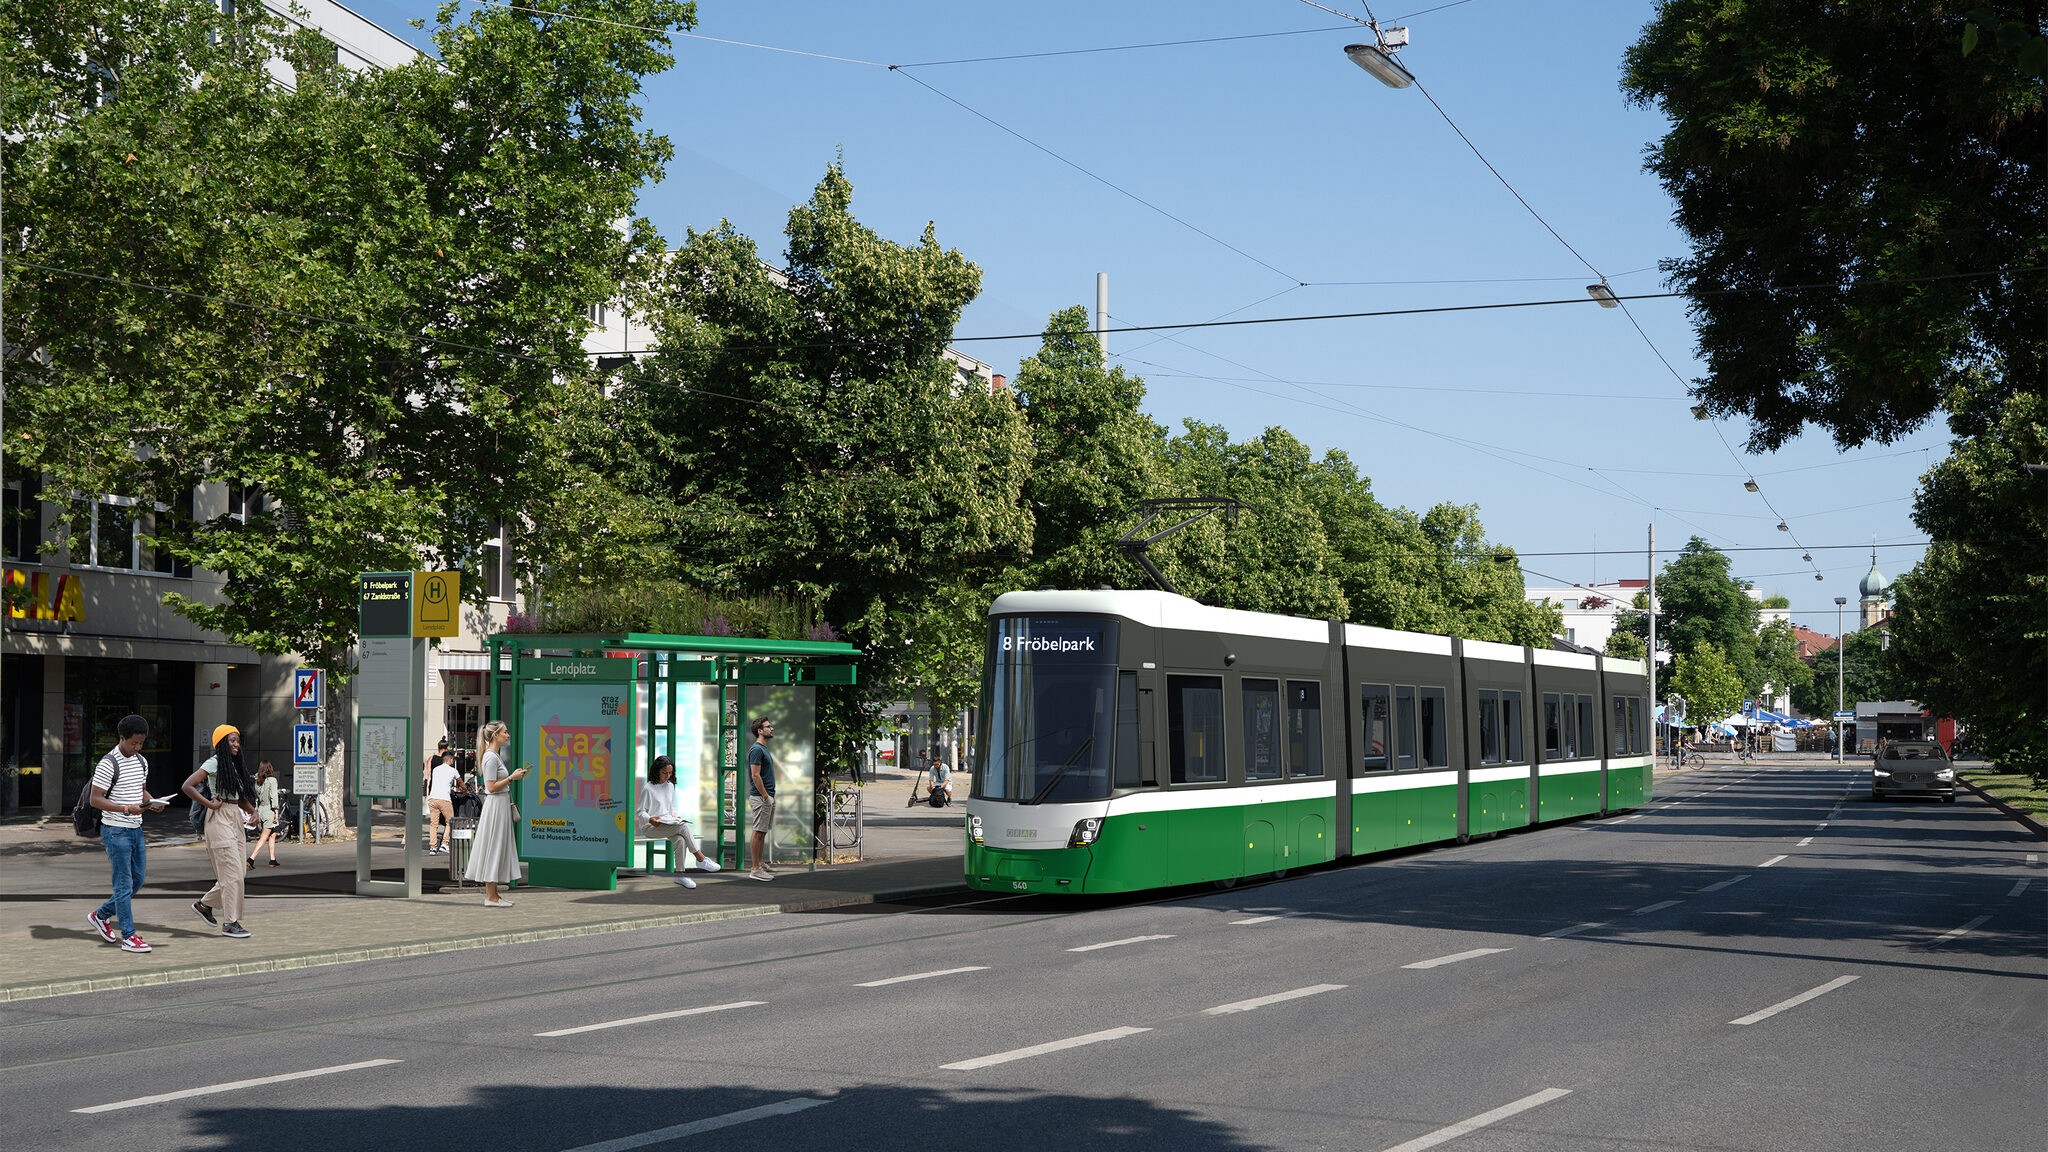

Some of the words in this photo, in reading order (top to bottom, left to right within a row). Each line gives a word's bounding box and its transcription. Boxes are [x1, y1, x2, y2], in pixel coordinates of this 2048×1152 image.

[363, 581, 368, 589] 8
[370, 581, 397, 590] Fröbelpark
[404, 580, 409, 588] 0
[430, 582, 440, 598] H
[363, 592, 370, 600] 67
[362, 640, 367, 648] 8
[1003, 637, 1012, 651] 8
[1016, 636, 1095, 652] Fröbelpark
[362, 651, 370, 659] 67
[550, 662, 596, 677] Lendplatz
[545, 733, 606, 756] graz
[531, 819, 566, 827] Volksschule
[572, 835, 609, 844] Schlossberg
[1012, 881, 1027, 890] 540
